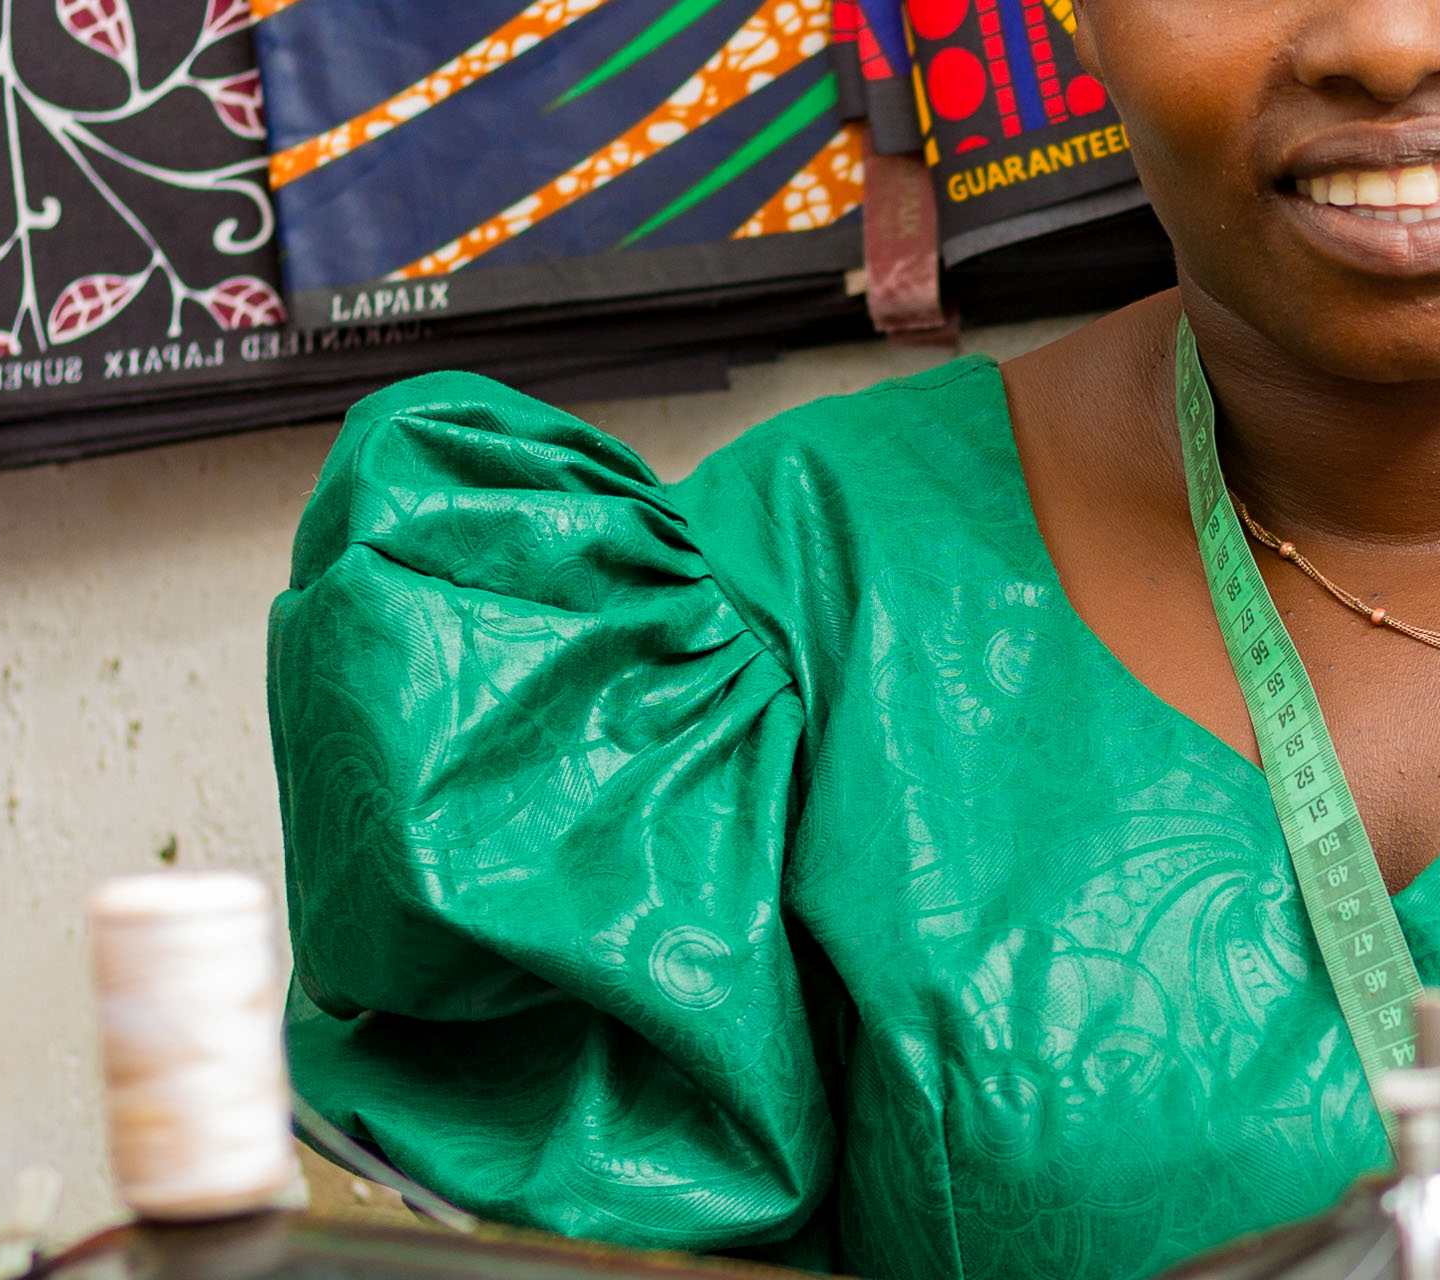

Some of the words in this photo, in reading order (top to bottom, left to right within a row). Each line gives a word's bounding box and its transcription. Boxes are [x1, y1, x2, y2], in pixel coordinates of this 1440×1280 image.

[332, 282, 449, 322] LAPAIX
[1216, 545, 1230, 570] 59
[1226, 576, 1242, 601] 58
[1241, 607, 1255, 634] 57
[1251, 639, 1270, 664] 56
[1267, 672, 1286, 697] 55
[1277, 704, 1297, 728] 54
[1285, 734, 1305, 757] 53
[1294, 766, 1315, 789] 52
[1308, 798, 1329, 823] 51
[1318, 832, 1341, 856] 50
[1327, 866, 1348, 887] 49
[1338, 898, 1360, 920] 48
[1354, 933, 1374, 956] 47
[1364, 969, 1387, 993] 46
[1378, 1007, 1402, 1031] 45
[1392, 1043, 1416, 1067] 44
